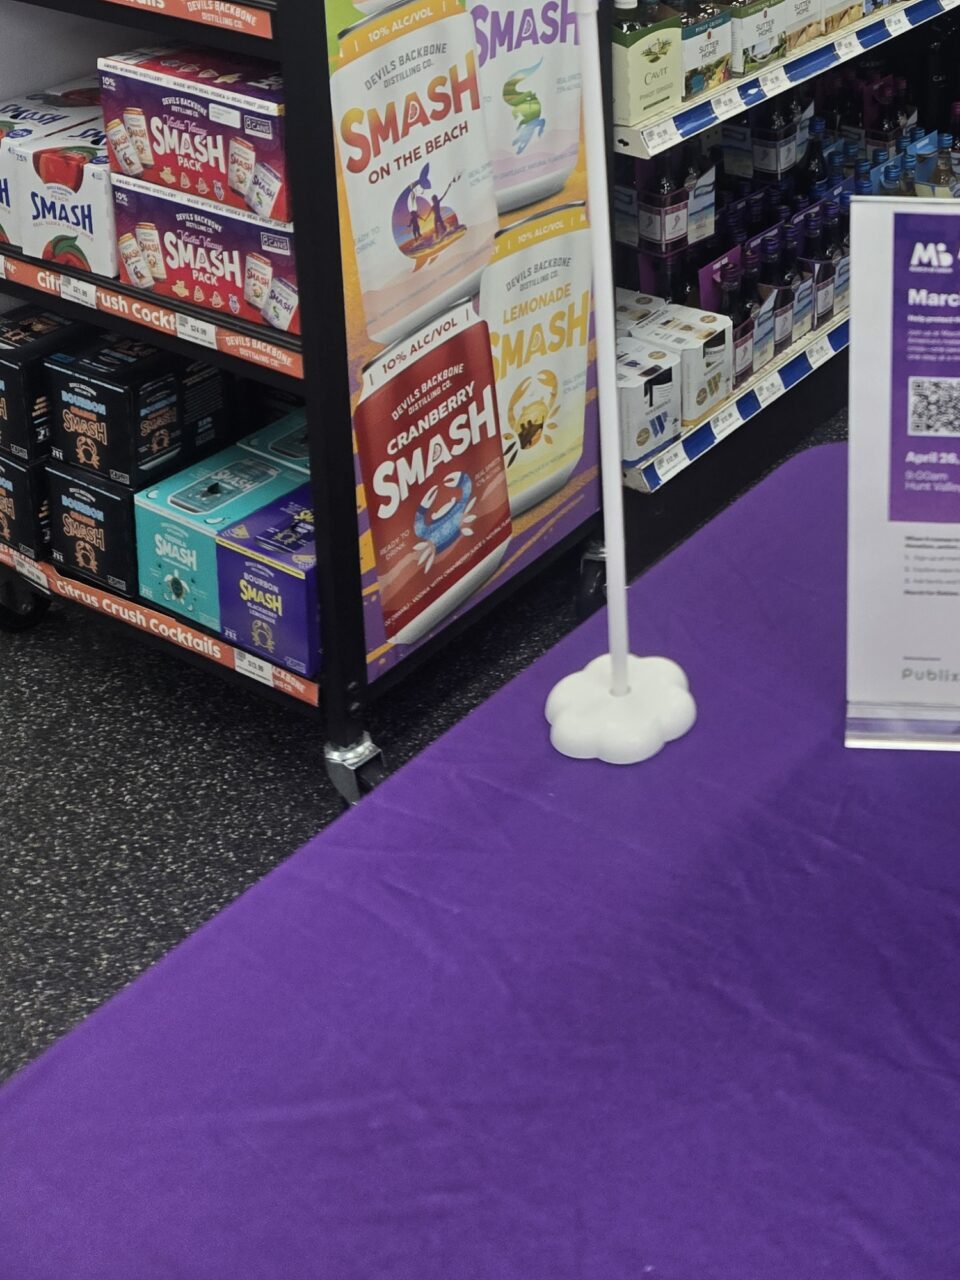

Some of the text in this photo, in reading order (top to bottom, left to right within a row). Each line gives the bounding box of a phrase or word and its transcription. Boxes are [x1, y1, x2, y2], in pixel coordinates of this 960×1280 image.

[368, 6, 433, 41] 10% ALC/VOL
[364, 43, 448, 90] DEVILS BACKBONE
[340, 49, 480, 174] SMASH
[150, 116, 226, 175] SMASH
[177, 156, 203, 173] PACK
[368, 121, 469, 185] ON THE BEACH
[30, 191, 94, 235] SMASH
[503, 283, 572, 324] LEMONADE
[381, 317, 458, 375] 10% ALC/VOL
[391, 363, 465, 421] DEVILS BACKBONE
[62, 409, 108, 446] SMASH
[387, 381, 476, 455] CRANBERRY
[372, 385, 498, 519] SMASH
[905, 451, 938, 465] April
[905, 482, 931, 491] Hunt
[155, 534, 197, 571] SMASH
[239, 579, 283, 617] SMASH
[243, 572, 279, 593] BOURBON
[56, 580, 221, 659] Citrus Crush Cocktails
[902, 668, 960, 682] Publix
